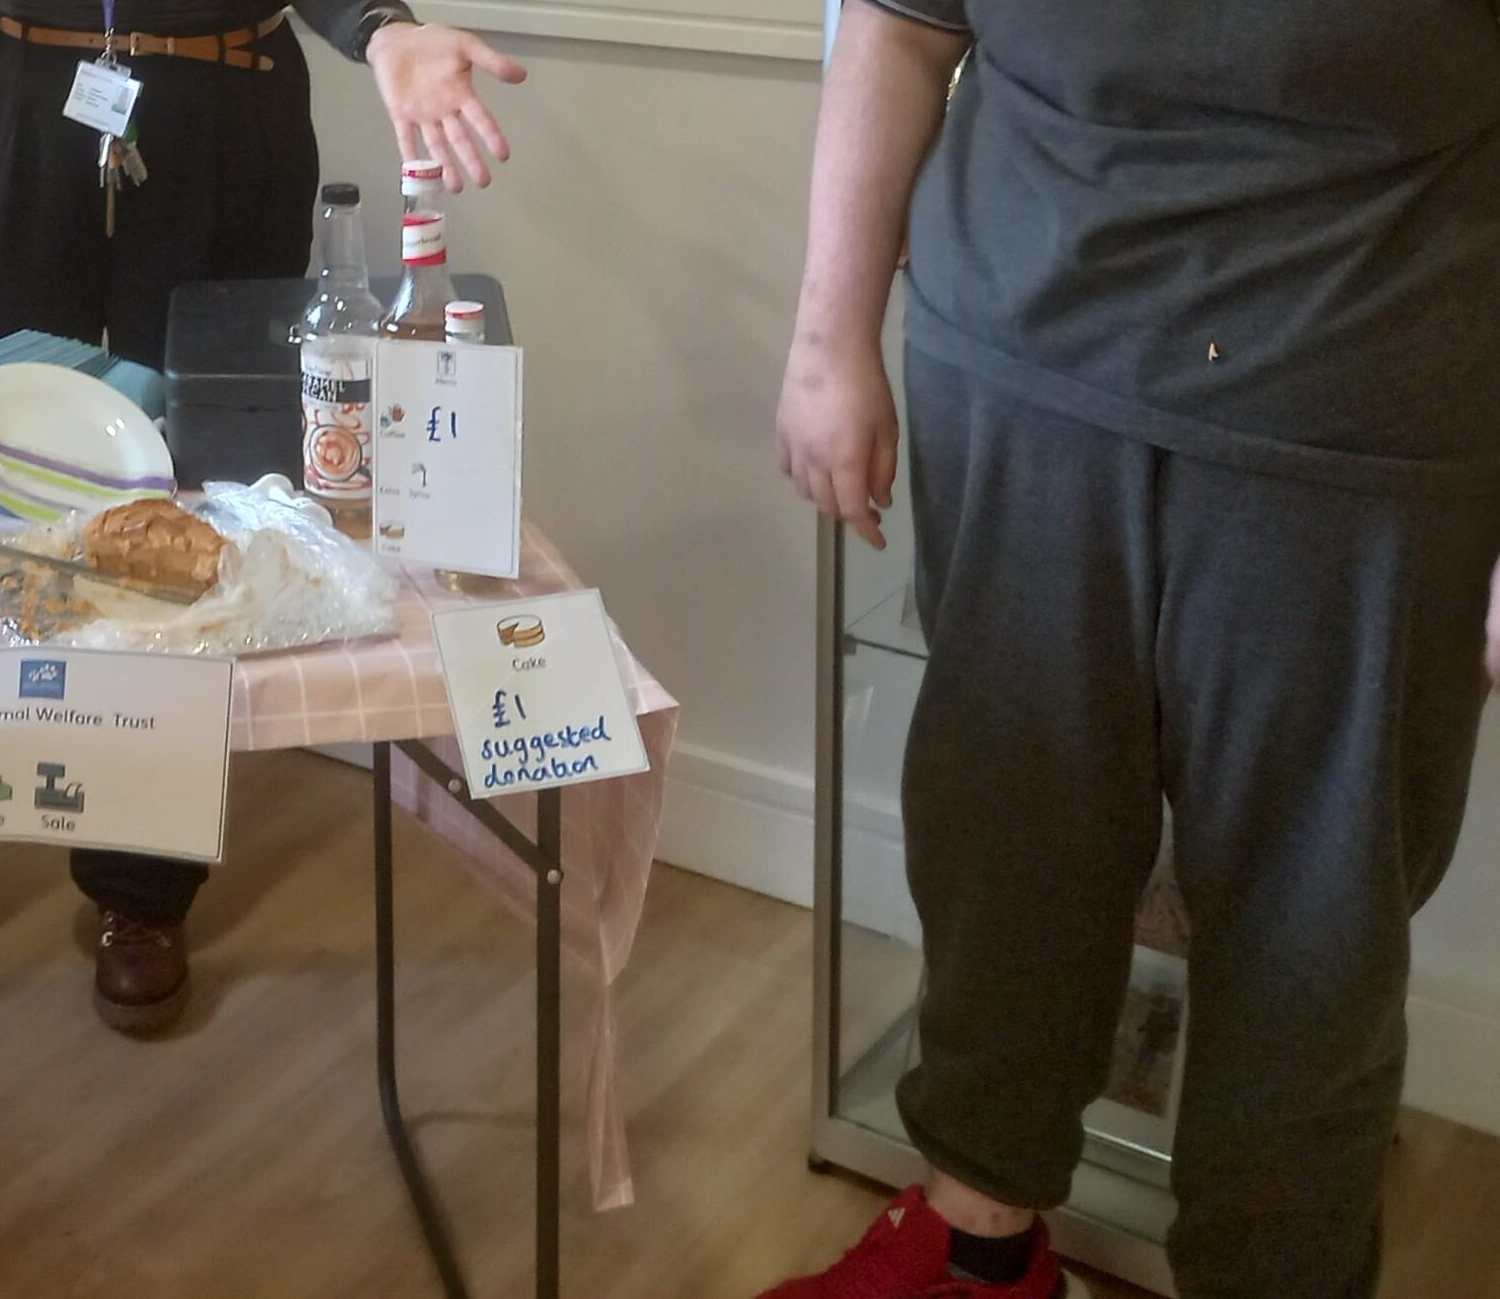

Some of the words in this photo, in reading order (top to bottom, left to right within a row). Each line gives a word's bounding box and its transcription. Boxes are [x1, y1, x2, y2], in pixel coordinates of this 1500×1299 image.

[426, 406, 456, 442] £1
[512, 657, 546, 672] Cake
[35, 707, 102, 726] Welfare
[113, 714, 155, 730] Trust
[492, 690, 527, 728] £1
[481, 715, 612, 764] suggested
[484, 754, 598, 788] donation
[40, 815, 76, 832] Sale
